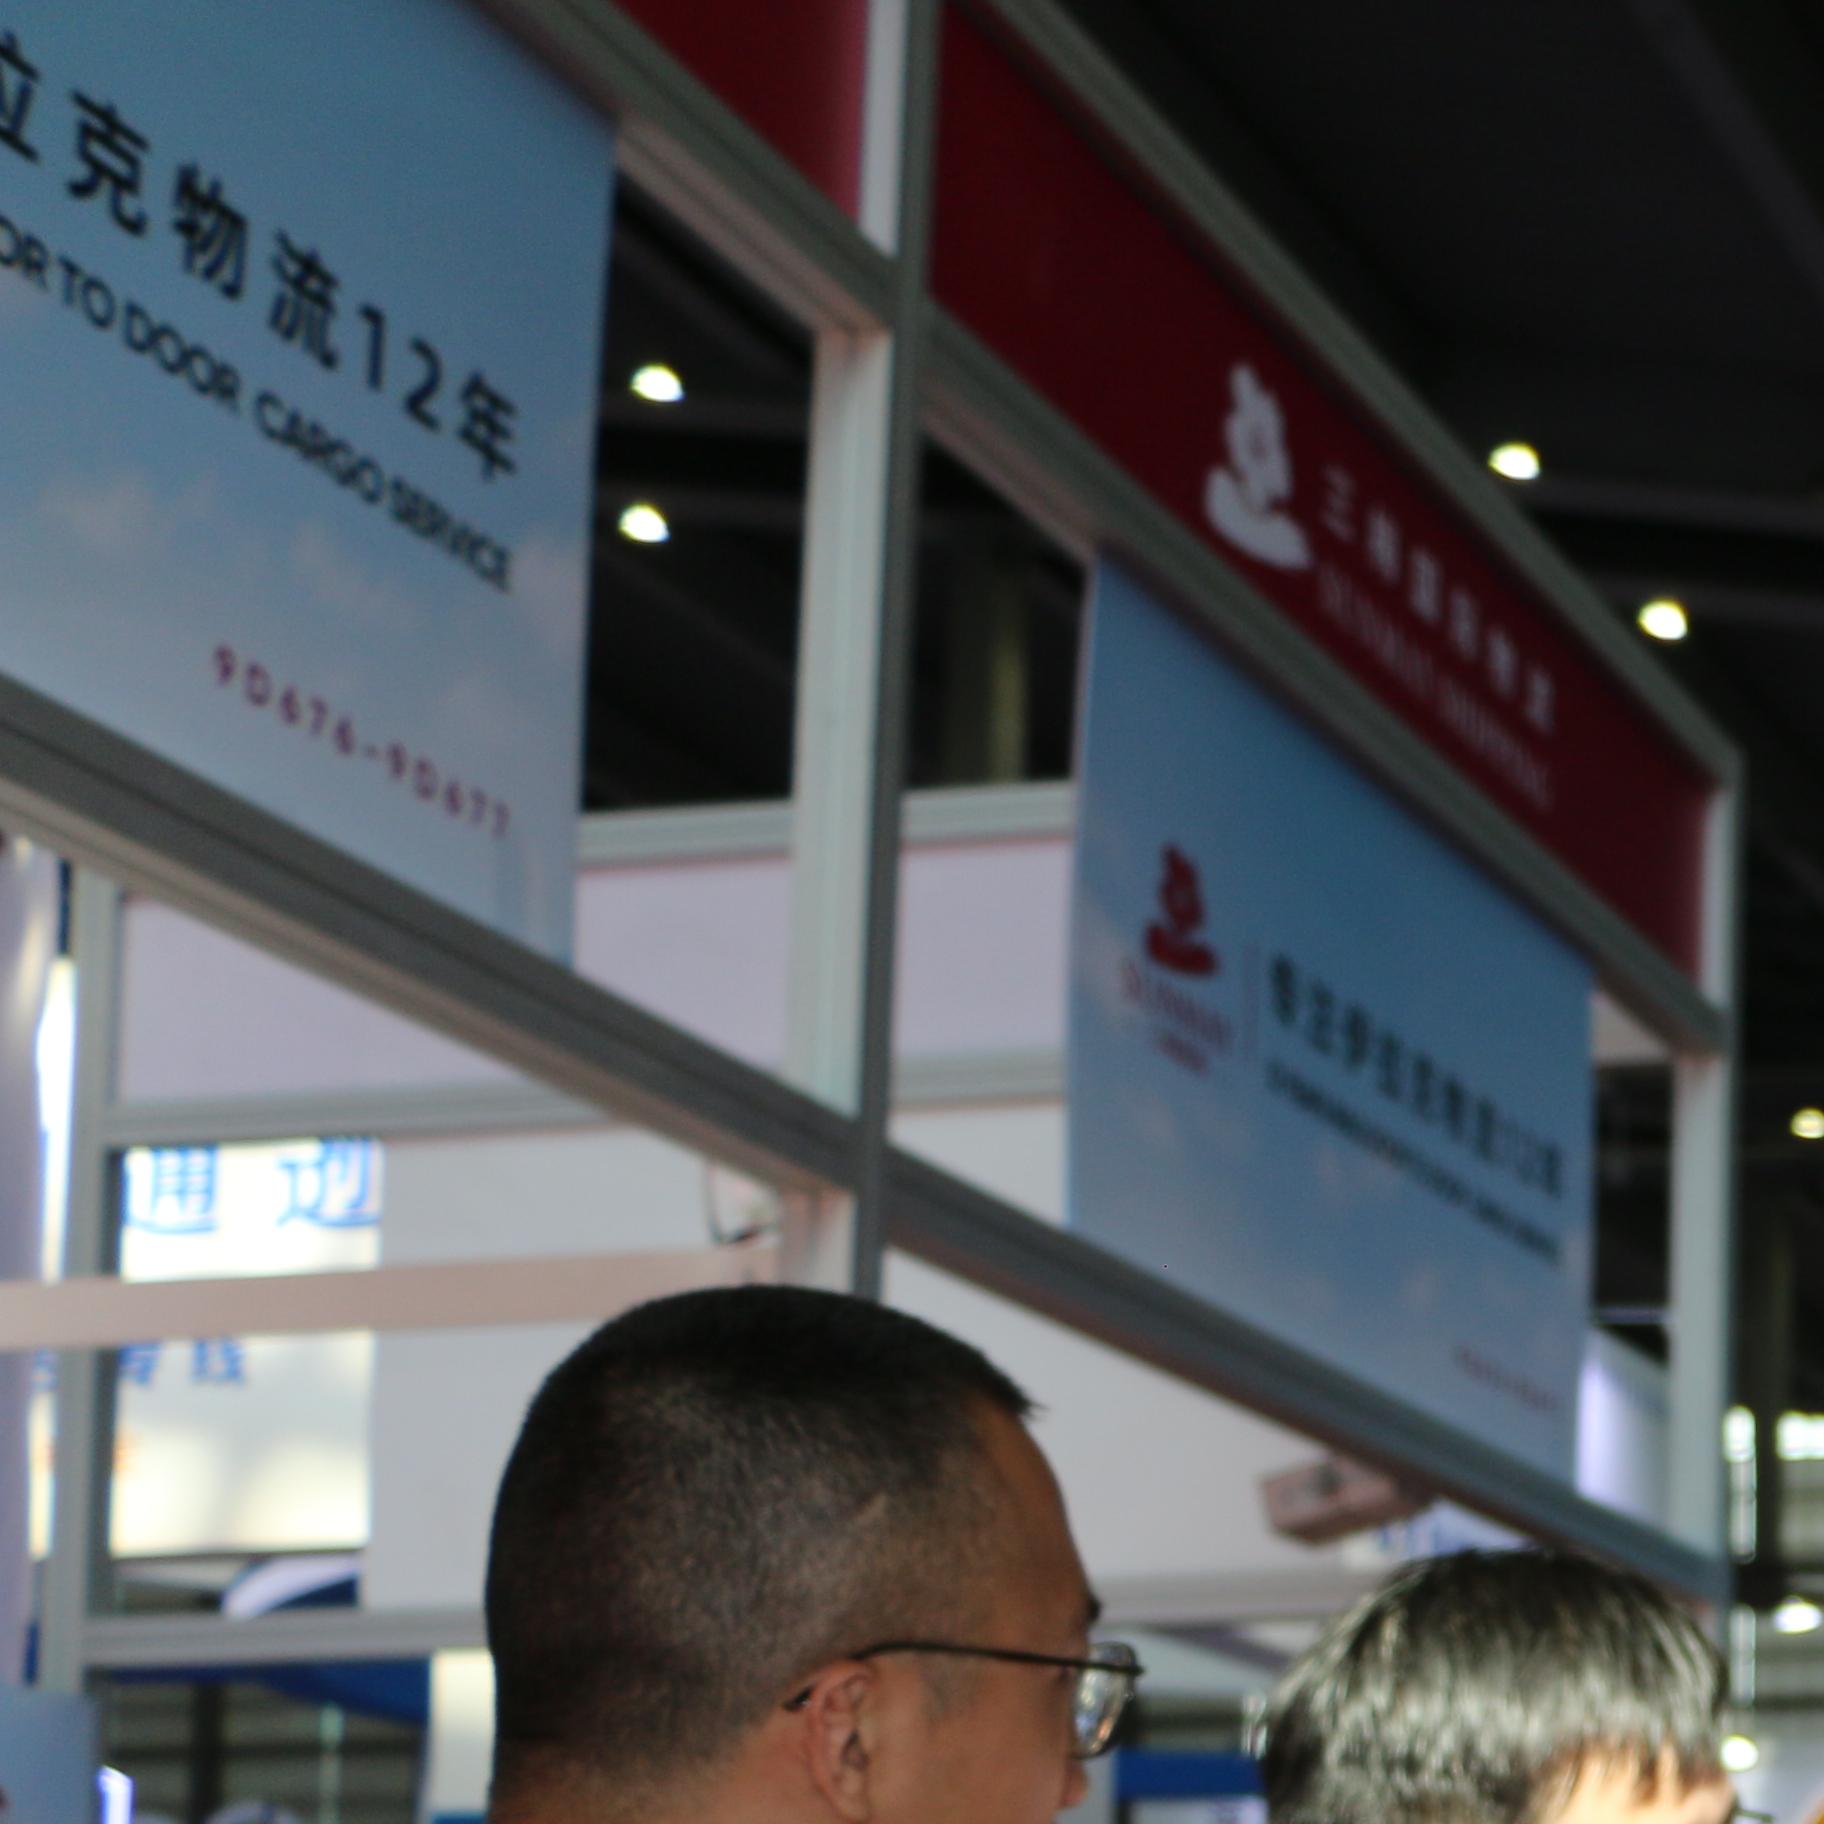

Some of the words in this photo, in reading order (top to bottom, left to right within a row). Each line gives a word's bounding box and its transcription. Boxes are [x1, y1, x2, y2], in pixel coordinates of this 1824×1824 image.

[58, 254, 117, 332] TO
[122, 315, 244, 415] DOOR
[254, 389, 386, 506] CARGO
[388, 474, 512, 592] SERVICE
